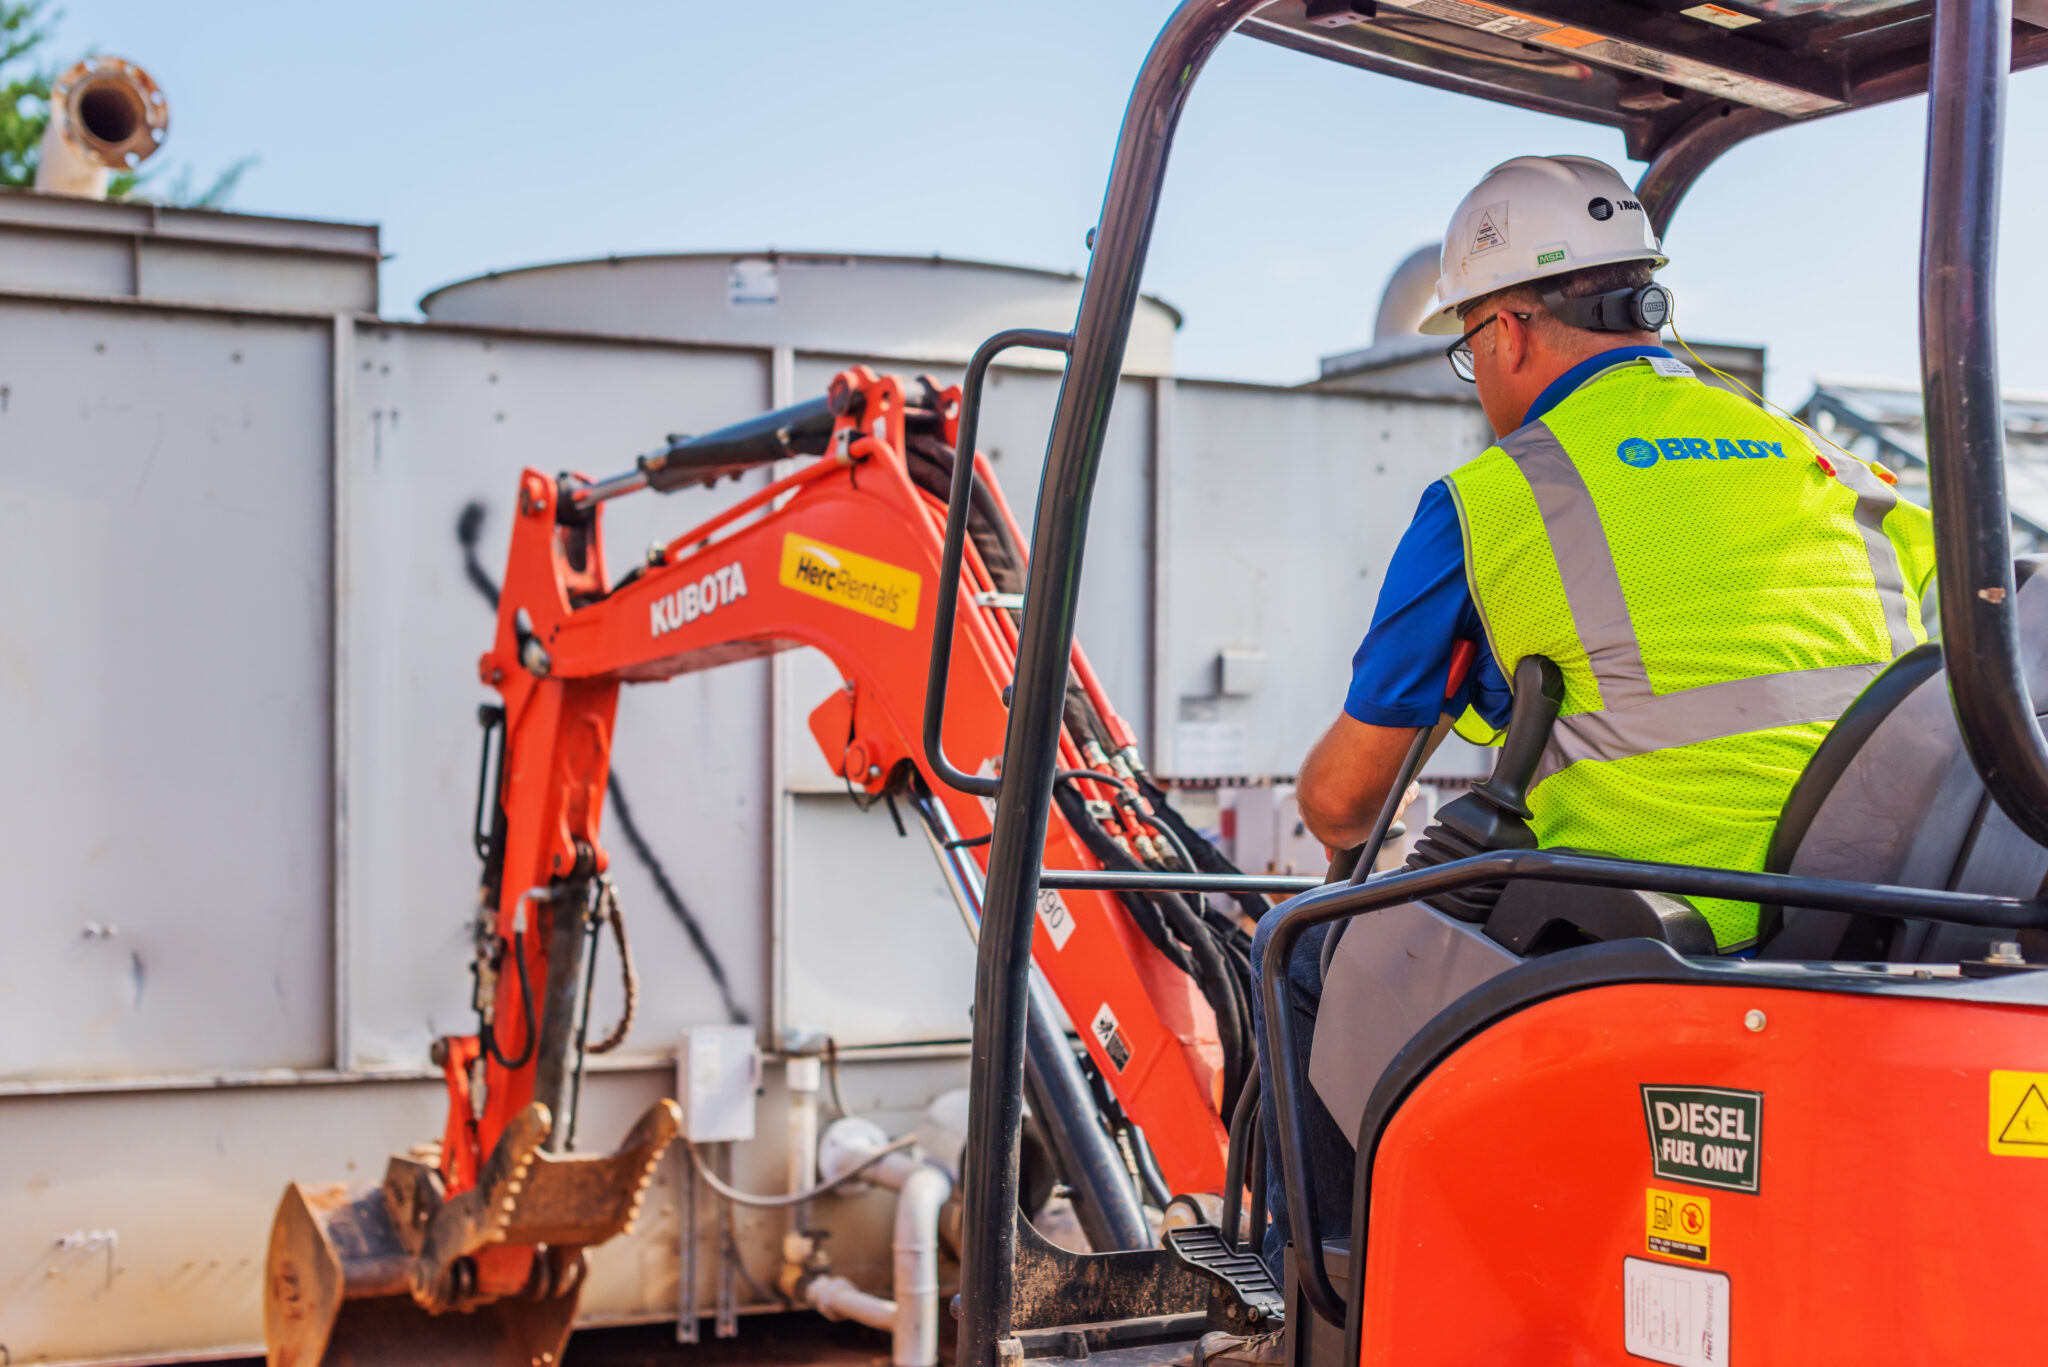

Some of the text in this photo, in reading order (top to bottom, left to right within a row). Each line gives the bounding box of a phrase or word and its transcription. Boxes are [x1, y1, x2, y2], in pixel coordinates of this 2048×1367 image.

[1539, 251, 1564, 264] MSA
[1645, 302, 1664, 312] MSA
[1655, 437, 1787, 460] BRADY
[650, 561, 747, 638] KUBOTA
[1655, 1101, 1751, 1142] DIESEL
[1662, 1138, 1748, 1174] FUEL ONLY
